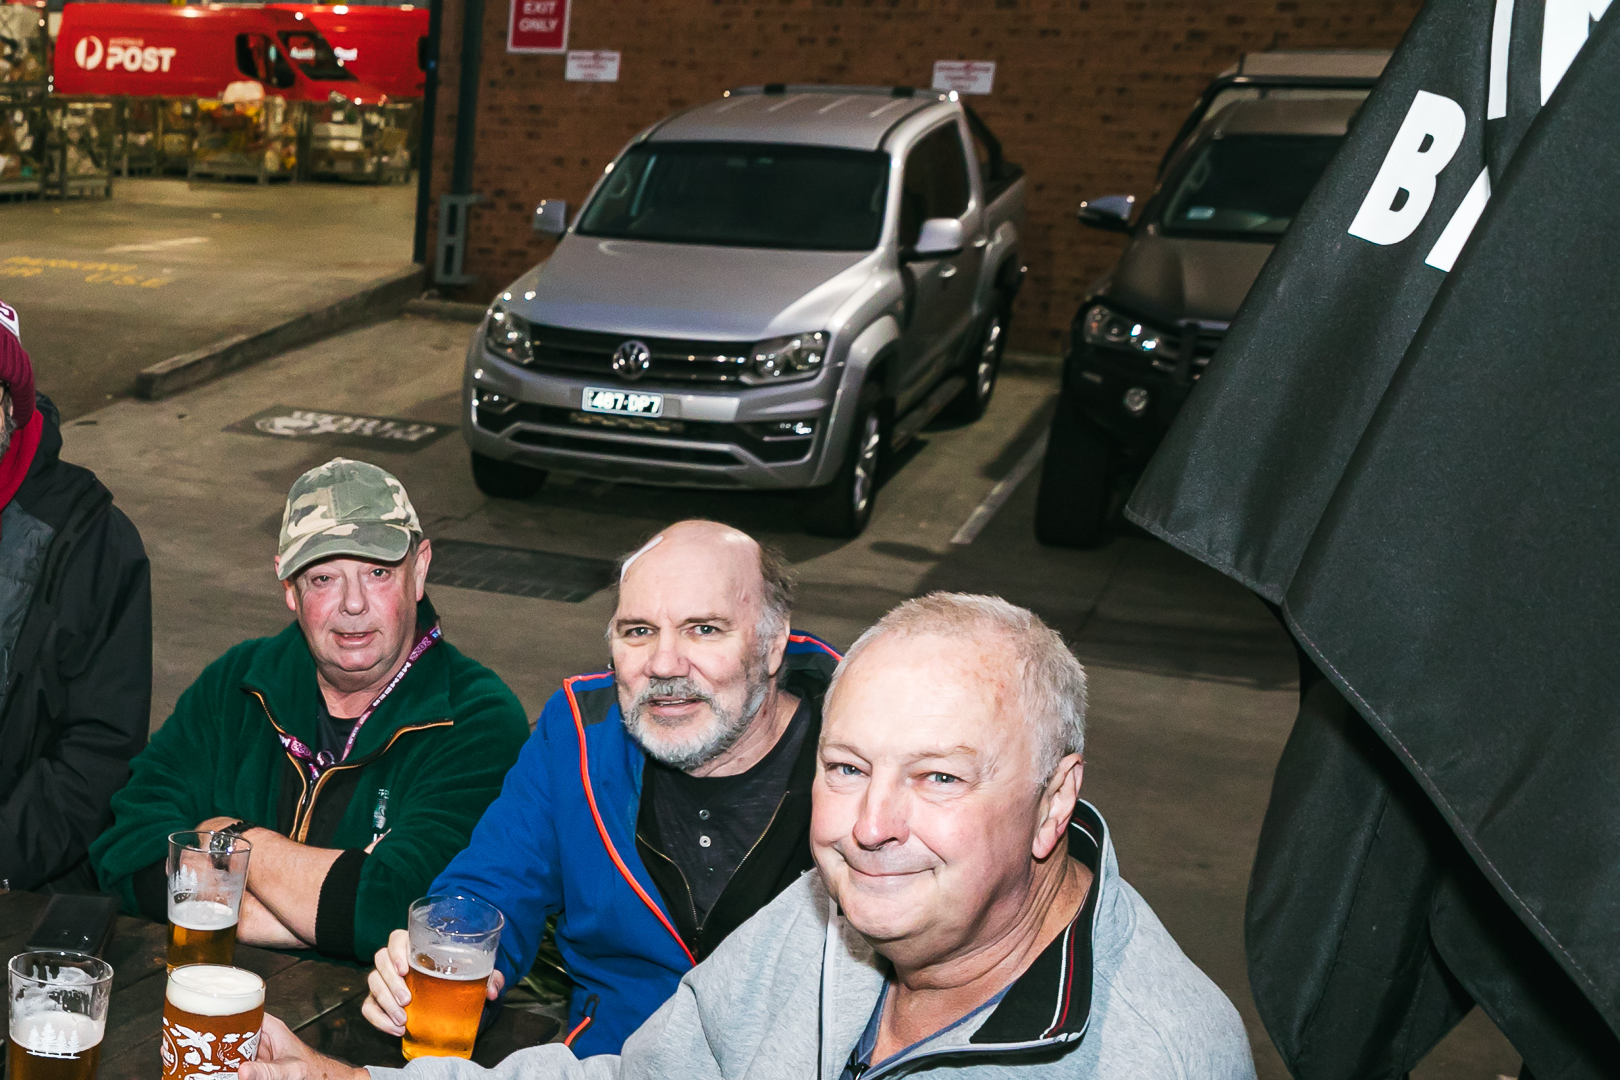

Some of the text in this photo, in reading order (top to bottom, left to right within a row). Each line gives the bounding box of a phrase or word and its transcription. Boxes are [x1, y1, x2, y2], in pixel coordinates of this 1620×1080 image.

[522, 1, 557, 15] EXIT
[518, 18, 558, 32] ONLY
[106, 46, 177, 73] POST
[372, 661, 412, 707] MEMBER
